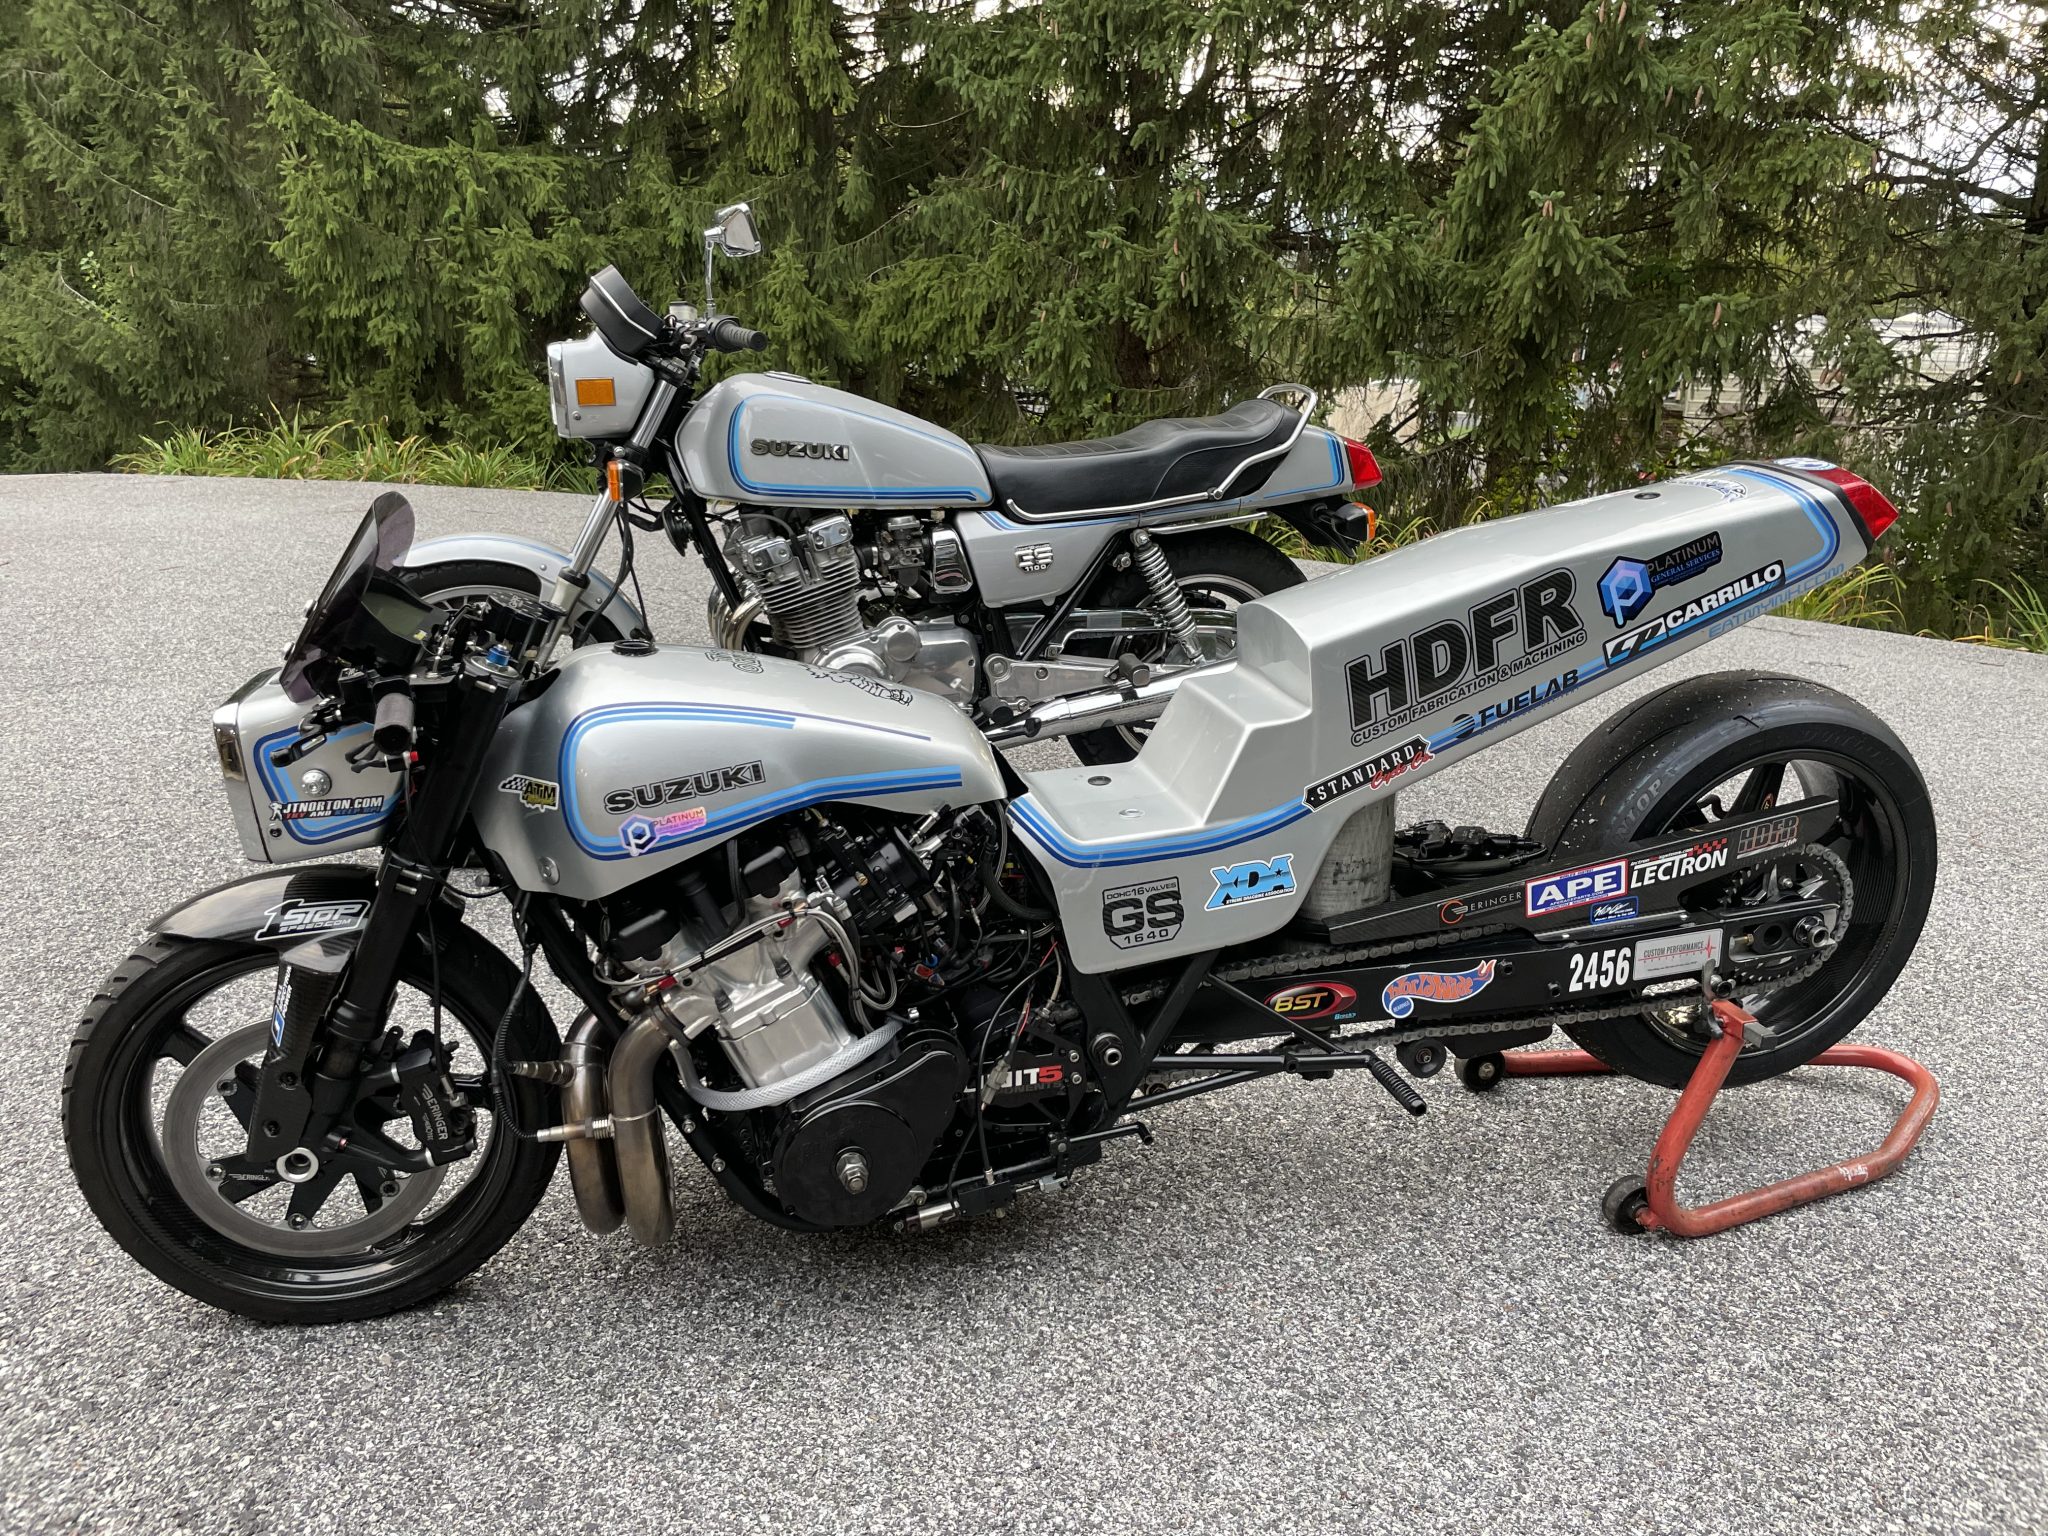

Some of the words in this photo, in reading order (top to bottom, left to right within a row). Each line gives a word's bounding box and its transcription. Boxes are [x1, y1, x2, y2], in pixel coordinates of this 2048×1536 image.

[750, 438, 849, 461] SUZUKI
[1025, 564, 1047, 572] 1100
[1647, 535, 1719, 575] PLATINUM
[1651, 564, 1685, 583] GENERAL
[1686, 548, 1720, 569] SERVICES
[1667, 563, 1782, 629] CARRILLO
[1346, 569, 1584, 731] HDFR
[1353, 713, 1409, 744] CUSTOM
[1411, 675, 1497, 718] FABRICATION
[1500, 666, 1511, 679] &
[1513, 631, 1586, 674] MACHINING
[1478, 668, 1580, 728] FUELAB
[604, 760, 766, 815] SUZUKI
[1317, 745, 1415, 801] STANDARD
[283, 797, 383, 814] JTNORTON.COM
[309, 810, 332, 818] AND
[653, 809, 704, 827] PLATINUM
[1206, 854, 1296, 909] XDA
[1631, 848, 1728, 889] LECTRON
[1536, 870, 1617, 906] APE
[280, 904, 363, 926] STOP
[1103, 890, 1184, 936] GS
[1124, 928, 1169, 944] 1640
[1644, 947, 1665, 958] CUSTOM
[1667, 941, 1704, 954] PERFORMANCE
[1569, 947, 1631, 992] 2456
[1275, 992, 1328, 1013] BST
